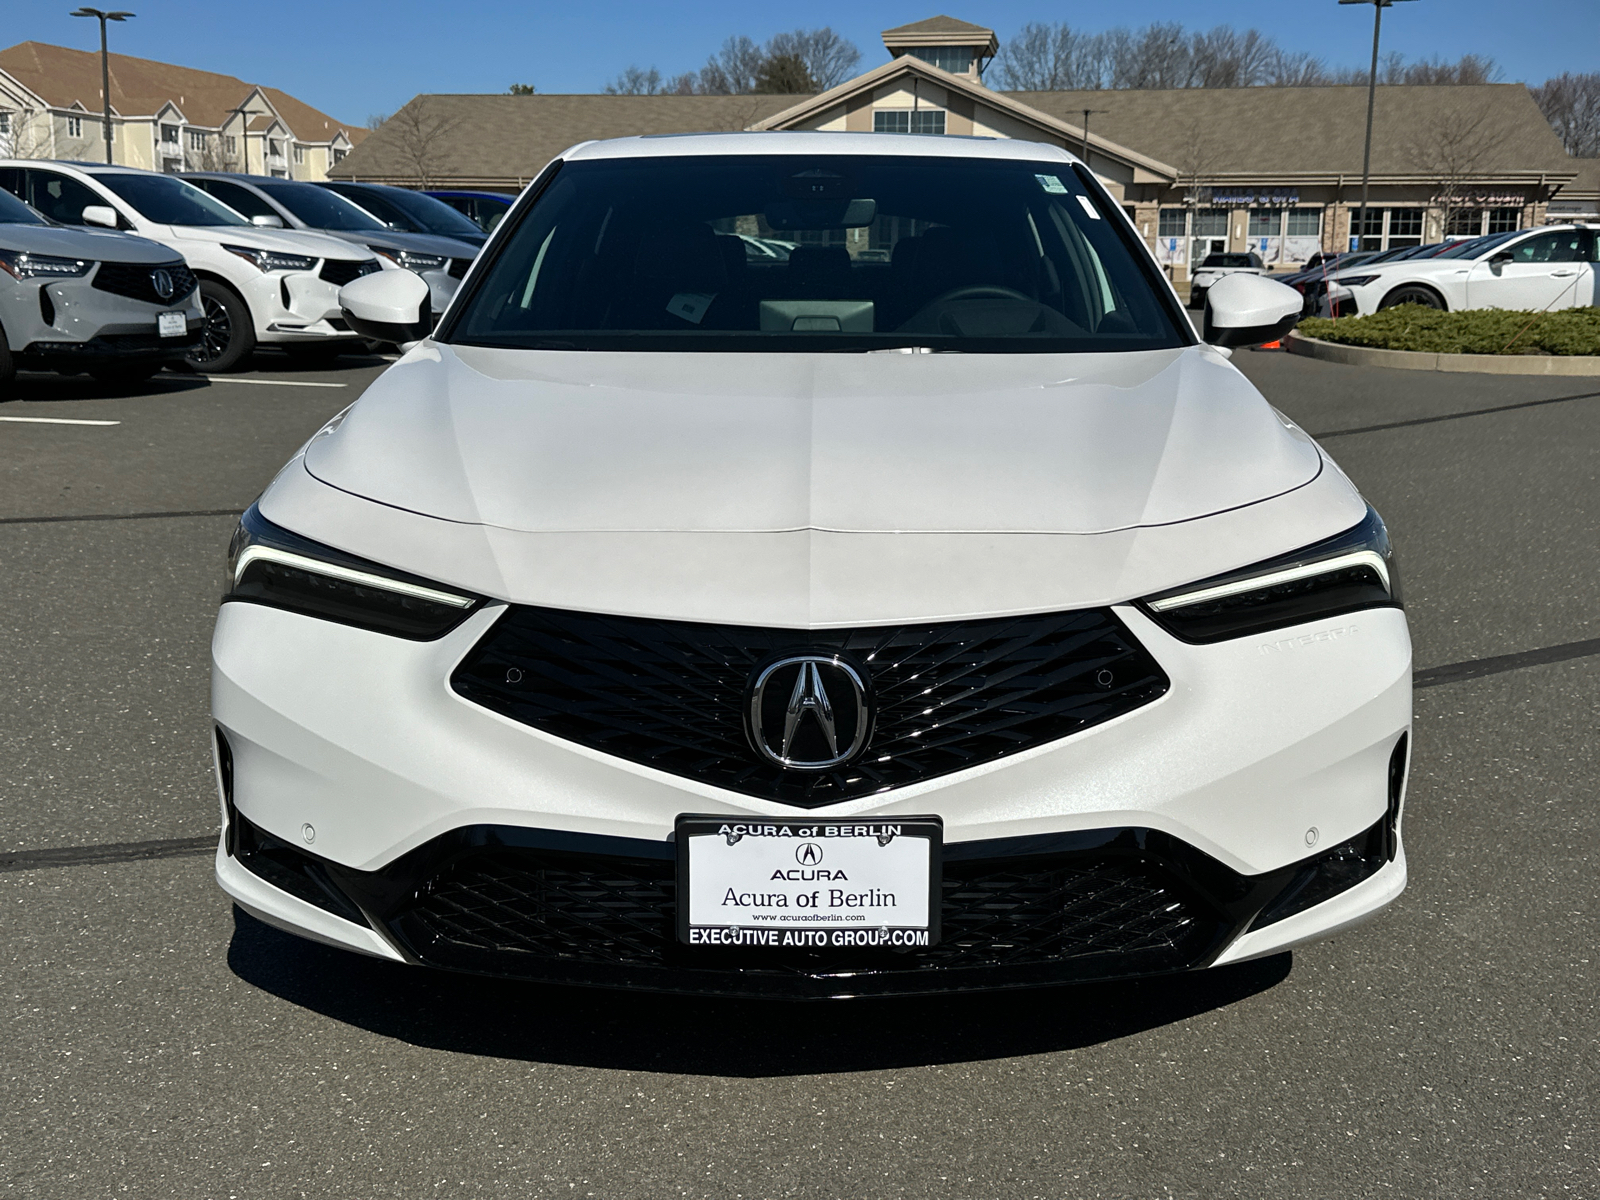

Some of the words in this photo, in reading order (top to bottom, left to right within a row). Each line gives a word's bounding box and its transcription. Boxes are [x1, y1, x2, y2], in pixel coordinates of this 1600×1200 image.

[1256, 625, 1361, 656] INTEGRA
[718, 824, 792, 837] ACURA
[798, 826, 820, 837] of
[825, 825, 902, 837] BERLIN
[770, 869, 849, 881] ACURA
[721, 887, 789, 908] Acura
[796, 891, 820, 908] of
[828, 888, 897, 908] Berlin
[752, 913, 866, 922] www.acuraofberlin.com
[689, 929, 779, 946] EXECUTIVE
[783, 930, 827, 946] AUTO
